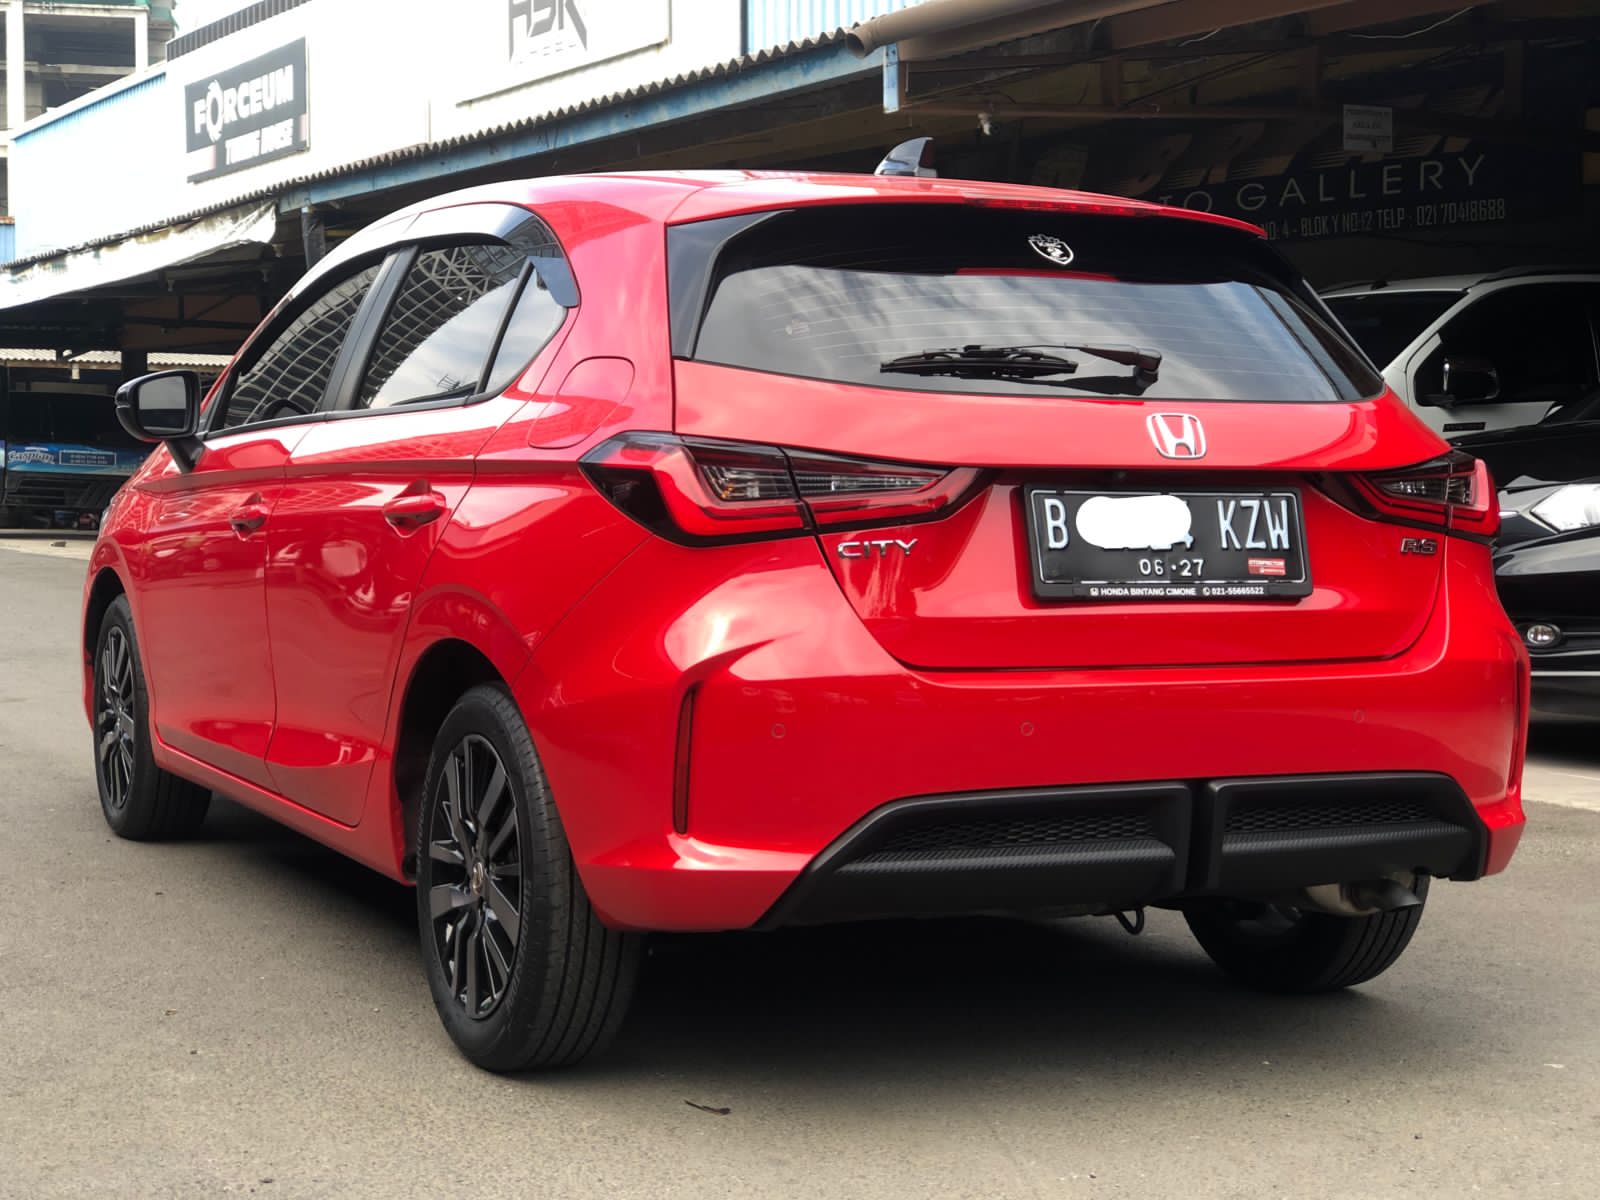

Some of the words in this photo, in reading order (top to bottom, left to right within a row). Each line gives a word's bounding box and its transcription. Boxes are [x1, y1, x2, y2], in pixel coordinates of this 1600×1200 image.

[194, 64, 294, 143] FORCEUM
[1236, 153, 1486, 212] GALLERY
[1299, 216, 1329, 238] BLOK
[1329, 215, 1339, 234] Y
[1376, 207, 1406, 229] TELP
[1044, 498, 1069, 549] B
[1216, 500, 1290, 549] KZW
[837, 538, 918, 559] CITY
[1100, 586, 1130, 597] HONDA
[1130, 586, 1165, 597] BINTANG
